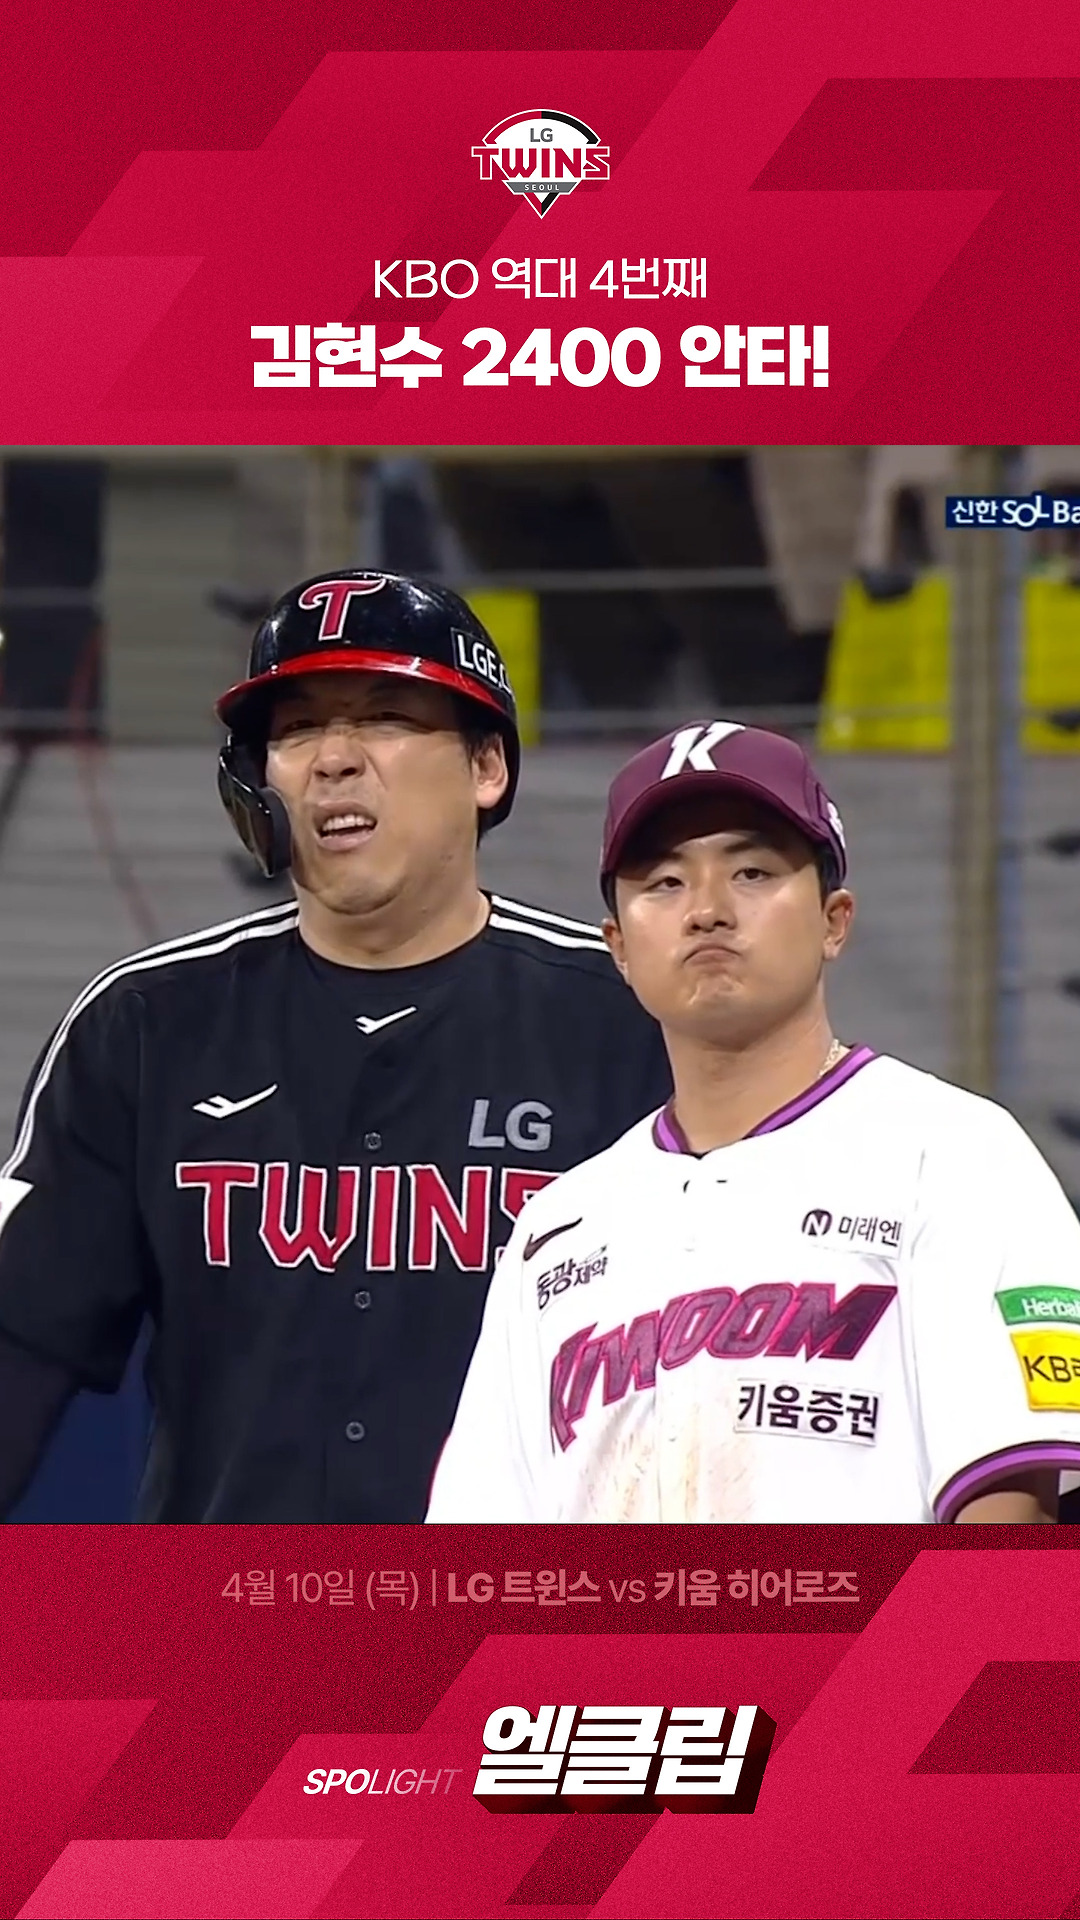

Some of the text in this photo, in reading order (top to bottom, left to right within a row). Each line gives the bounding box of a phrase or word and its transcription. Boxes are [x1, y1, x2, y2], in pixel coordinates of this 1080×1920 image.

[299, 578, 387, 641] T
[661, 721, 746, 780] K
[468, 1099, 553, 1152] LG
[838, 1216, 902, 1248] 미래엔
[737, 1384, 880, 1439] 키움증권
